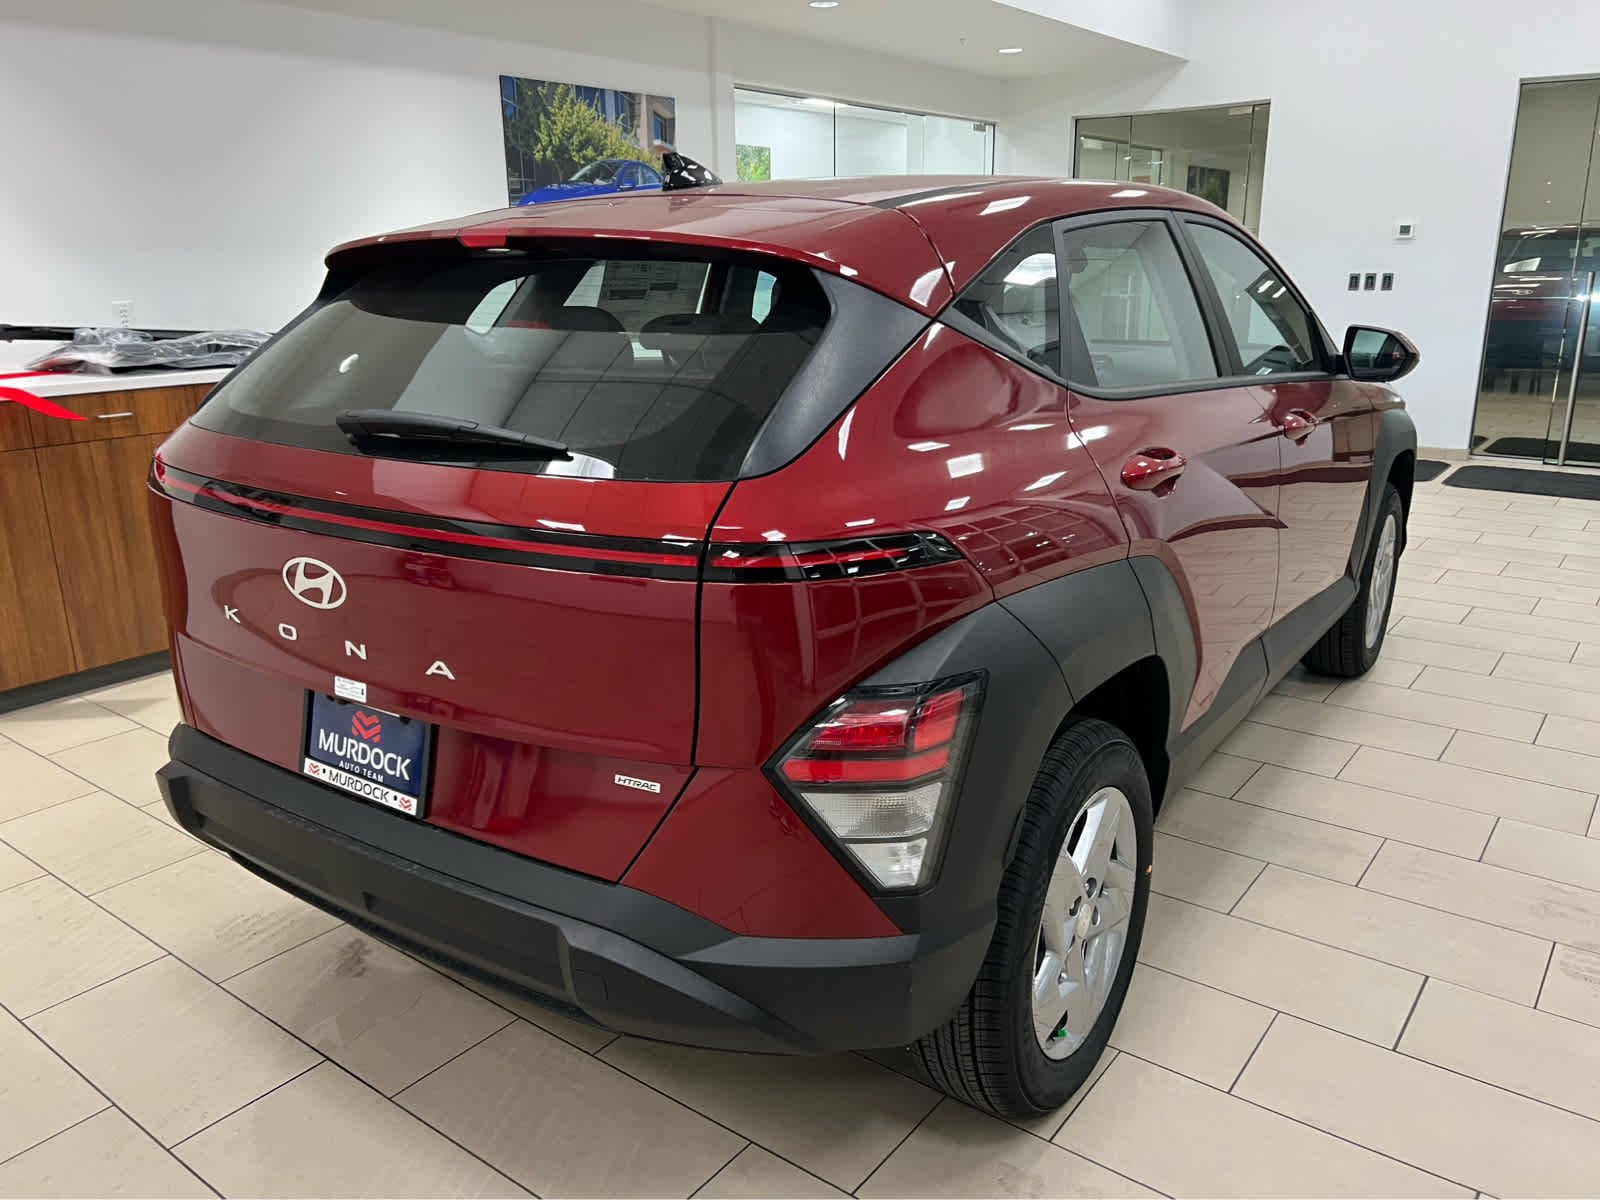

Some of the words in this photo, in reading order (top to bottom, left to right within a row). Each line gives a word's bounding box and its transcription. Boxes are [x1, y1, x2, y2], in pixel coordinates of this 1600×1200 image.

[224, 605, 455, 680] KONA
[319, 728, 410, 781] MURDOCK
[328, 769, 389, 802] MURDOCK
[339, 760, 361, 774] AUTO
[362, 768, 384, 783] TEAM
[617, 776, 657, 791] HTRAC
